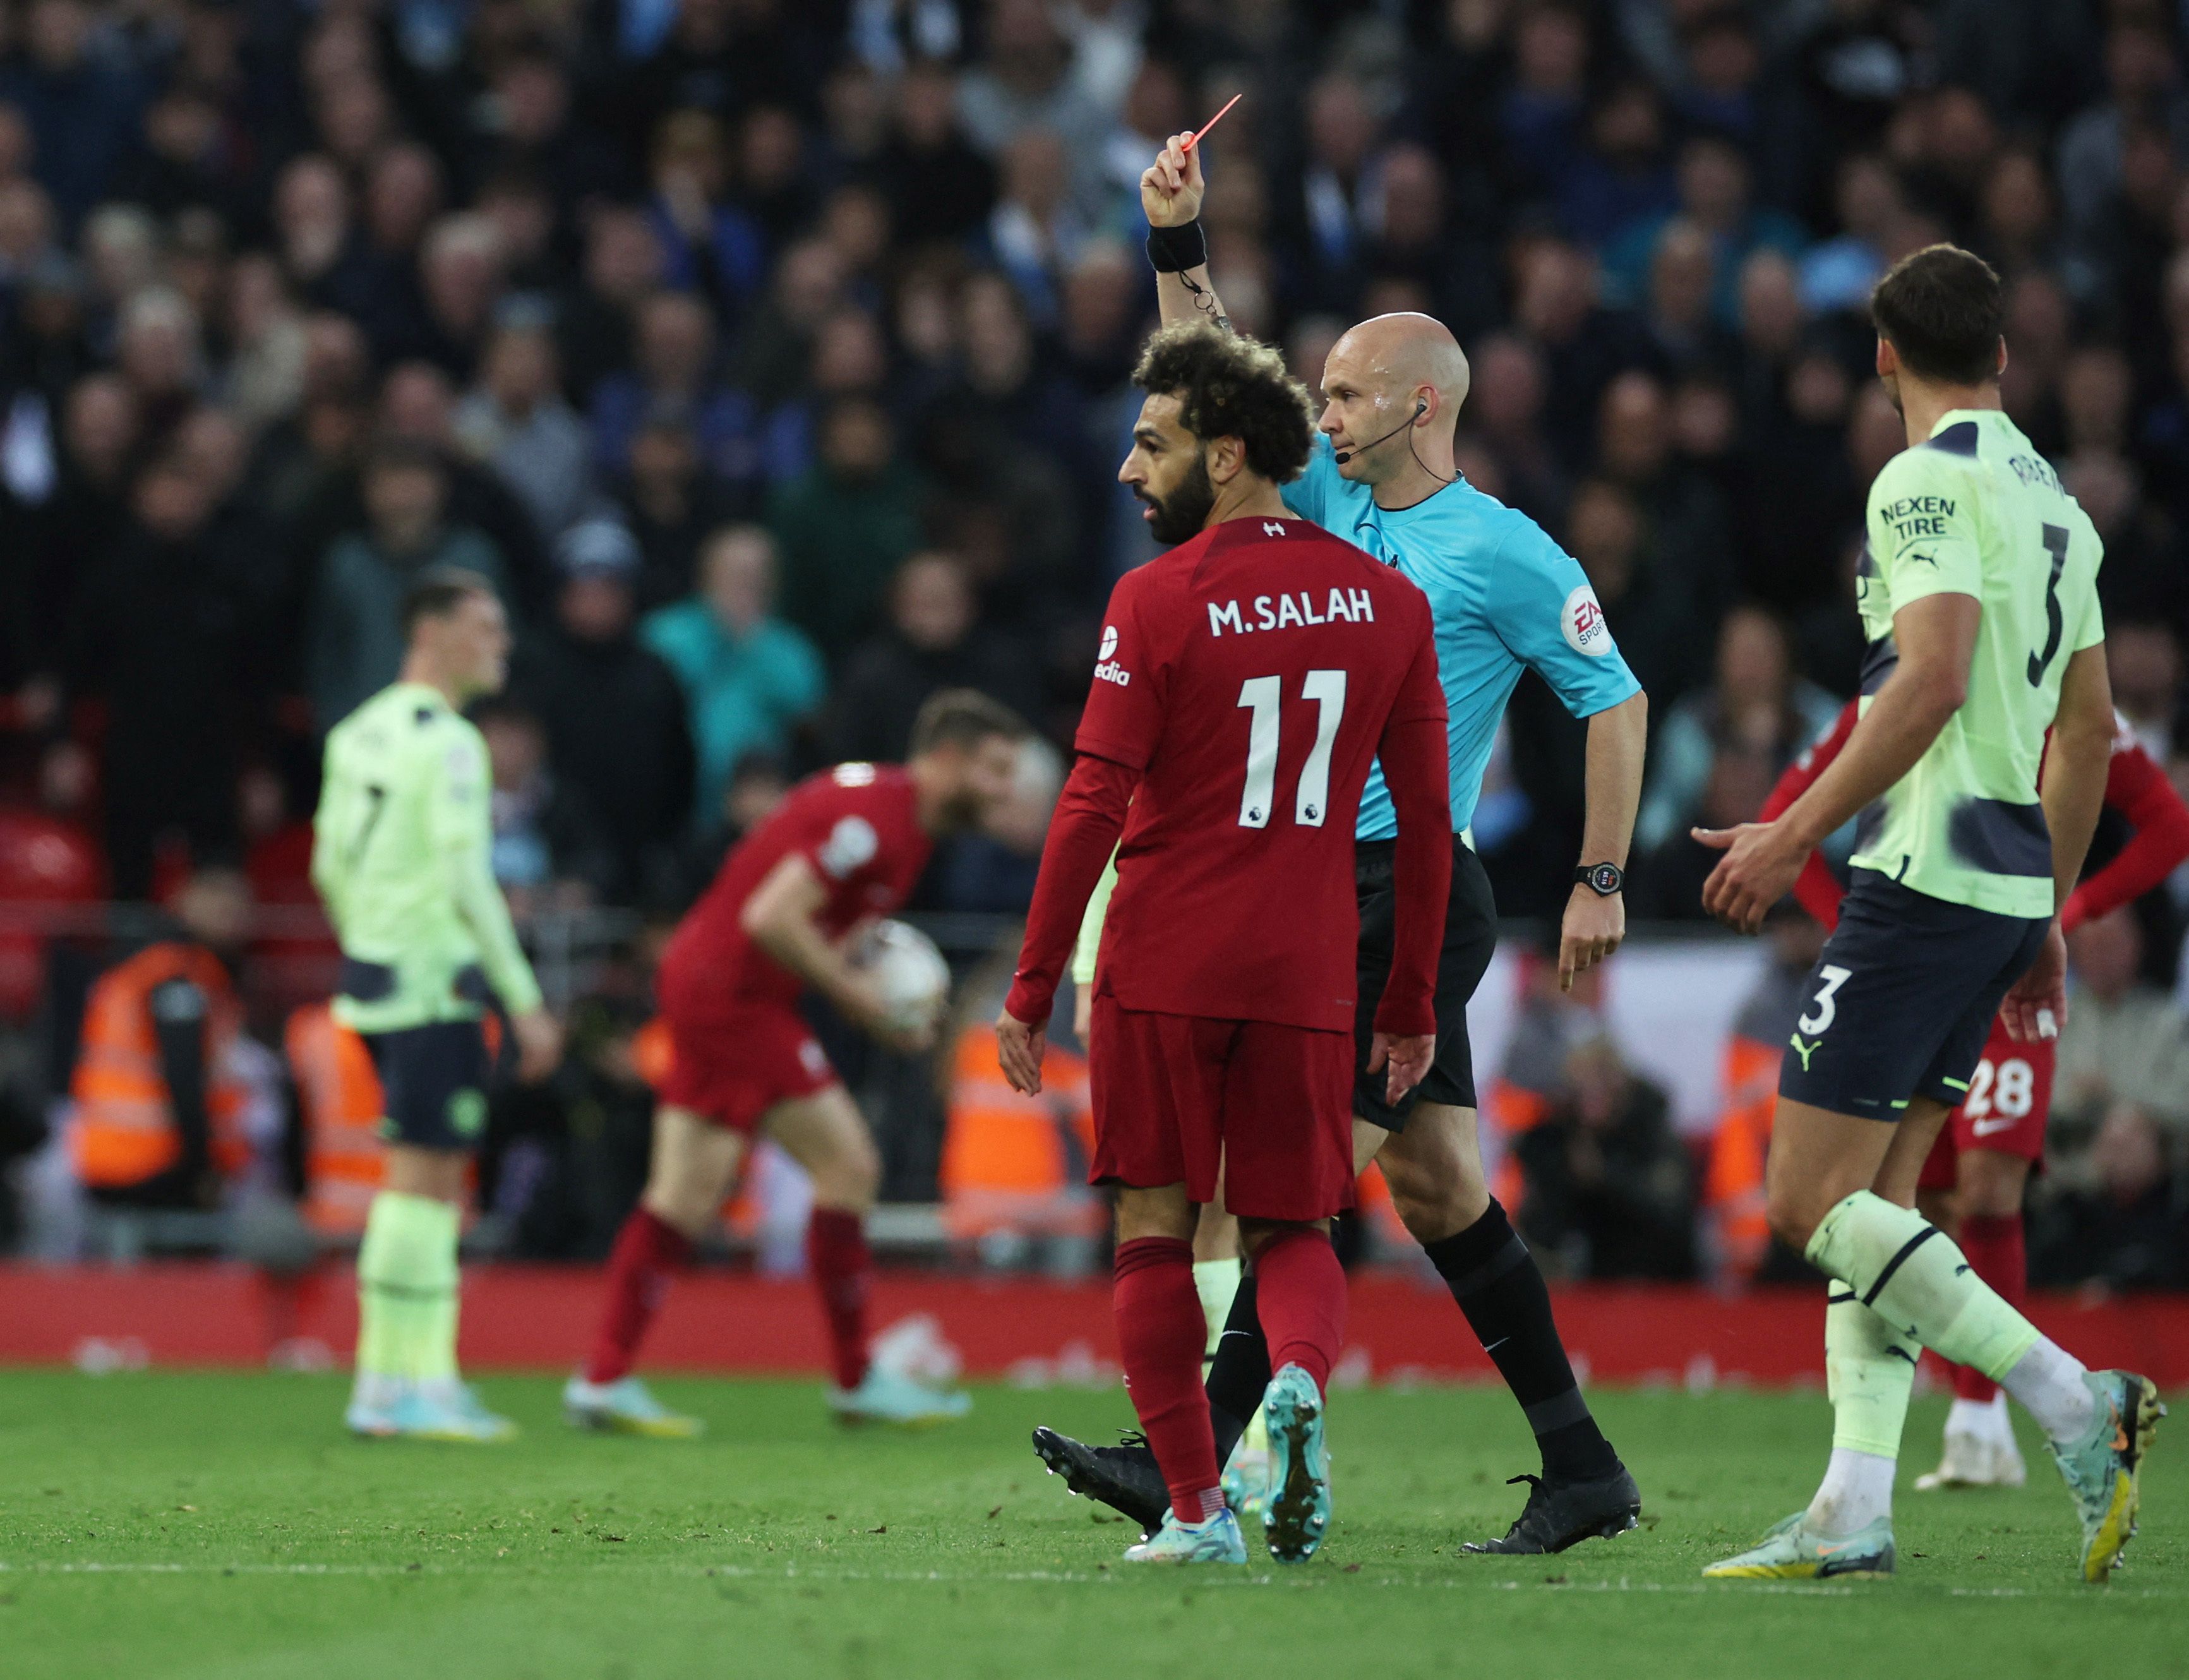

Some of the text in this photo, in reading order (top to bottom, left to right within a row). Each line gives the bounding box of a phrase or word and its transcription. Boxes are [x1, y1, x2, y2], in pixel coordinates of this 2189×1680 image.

[1881, 496, 1955, 525] NEXEN
[1895, 517, 1946, 539] TIRE
[1207, 587, 1374, 637] M.SALAH
[1574, 599, 1603, 635] EA
[2028, 522, 2070, 688] 3
[1580, 618, 1607, 645] SPORT
[1237, 669, 1347, 829] 11
[1797, 964, 1853, 1036] 3
[1963, 1057, 2034, 1119] 28
